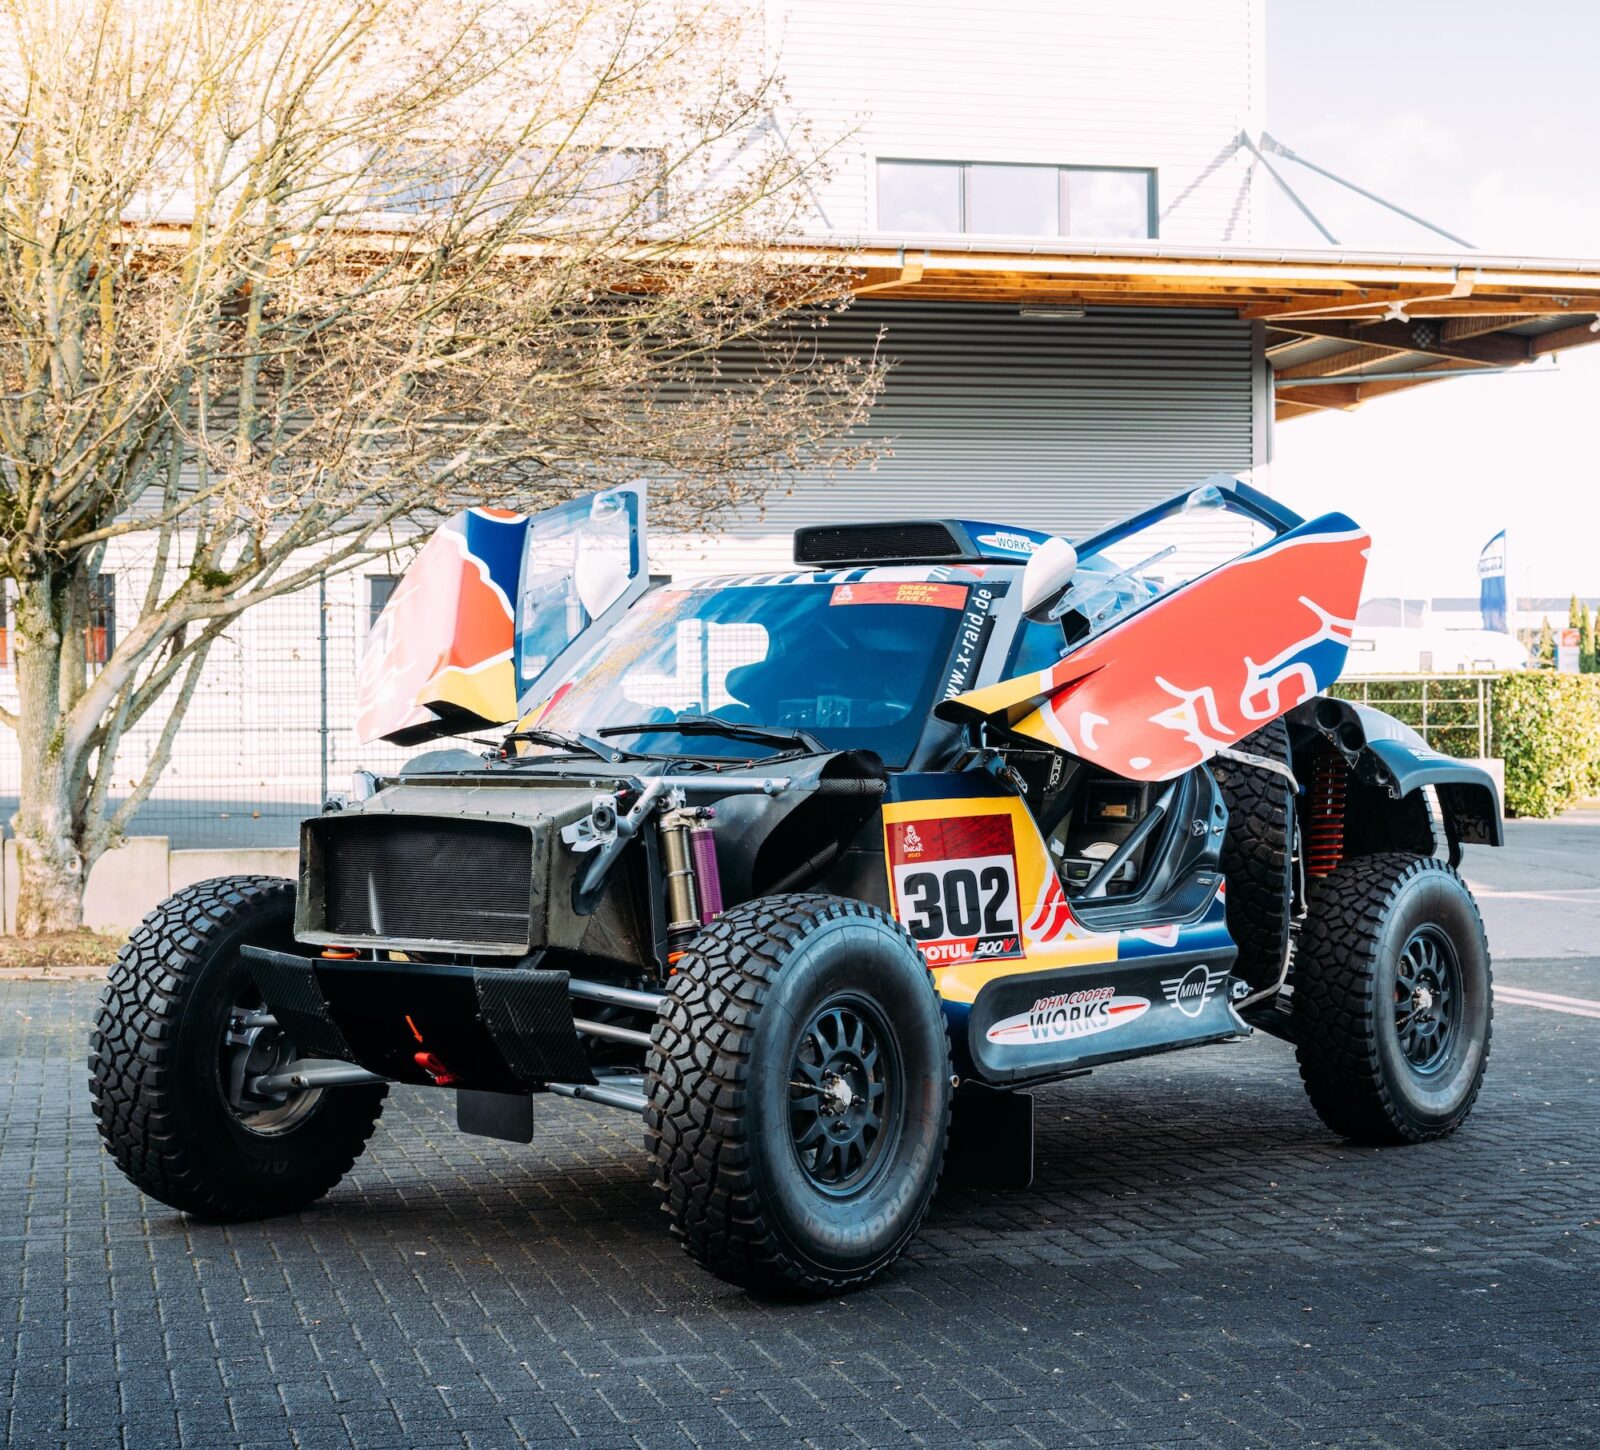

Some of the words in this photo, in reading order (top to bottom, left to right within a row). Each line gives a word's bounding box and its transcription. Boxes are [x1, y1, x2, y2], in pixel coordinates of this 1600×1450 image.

[997, 535, 1032, 552] WORKS
[899, 584, 939, 592] DREAM.
[943, 588, 992, 701] ww.x-raid.de
[904, 866, 1013, 940] 302
[976, 938, 1016, 955] 300V
[1030, 997, 1065, 1013] JOHN
[1069, 987, 1114, 1005] COOPER
[1180, 981, 1203, 999] MINI
[1029, 1001, 1109, 1040] WORKS
